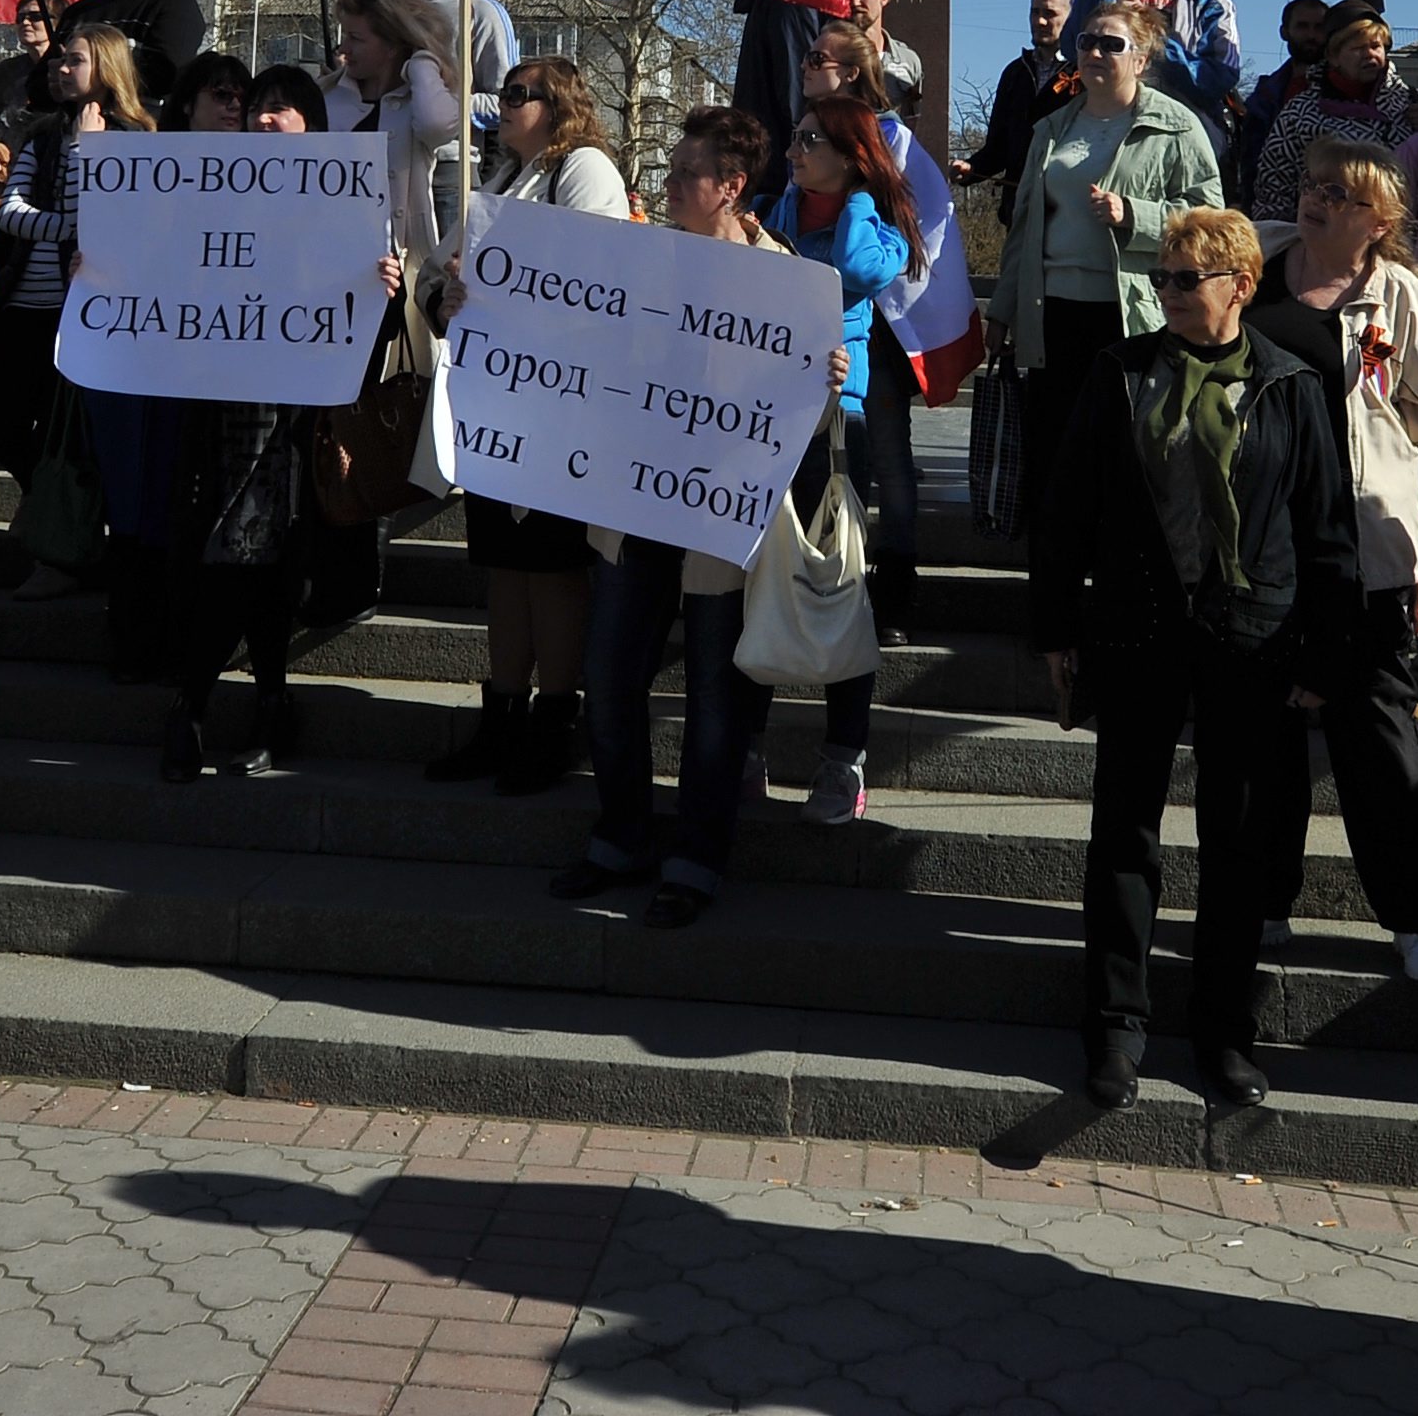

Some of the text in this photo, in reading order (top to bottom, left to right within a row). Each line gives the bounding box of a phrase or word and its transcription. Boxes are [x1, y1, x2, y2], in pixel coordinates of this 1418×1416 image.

[79, 156, 386, 208] ЮГО-ВОСТОК,
[199, 231, 256, 268] НЕ
[80, 291, 355, 345] СДАВАЙСЯ!
[475, 245, 627, 318] Одесса
[677, 303, 814, 371] мама,
[450, 326, 590, 401] Город
[640, 381, 783, 457] герой,
[454, 419, 774, 532] мы с тобой!
